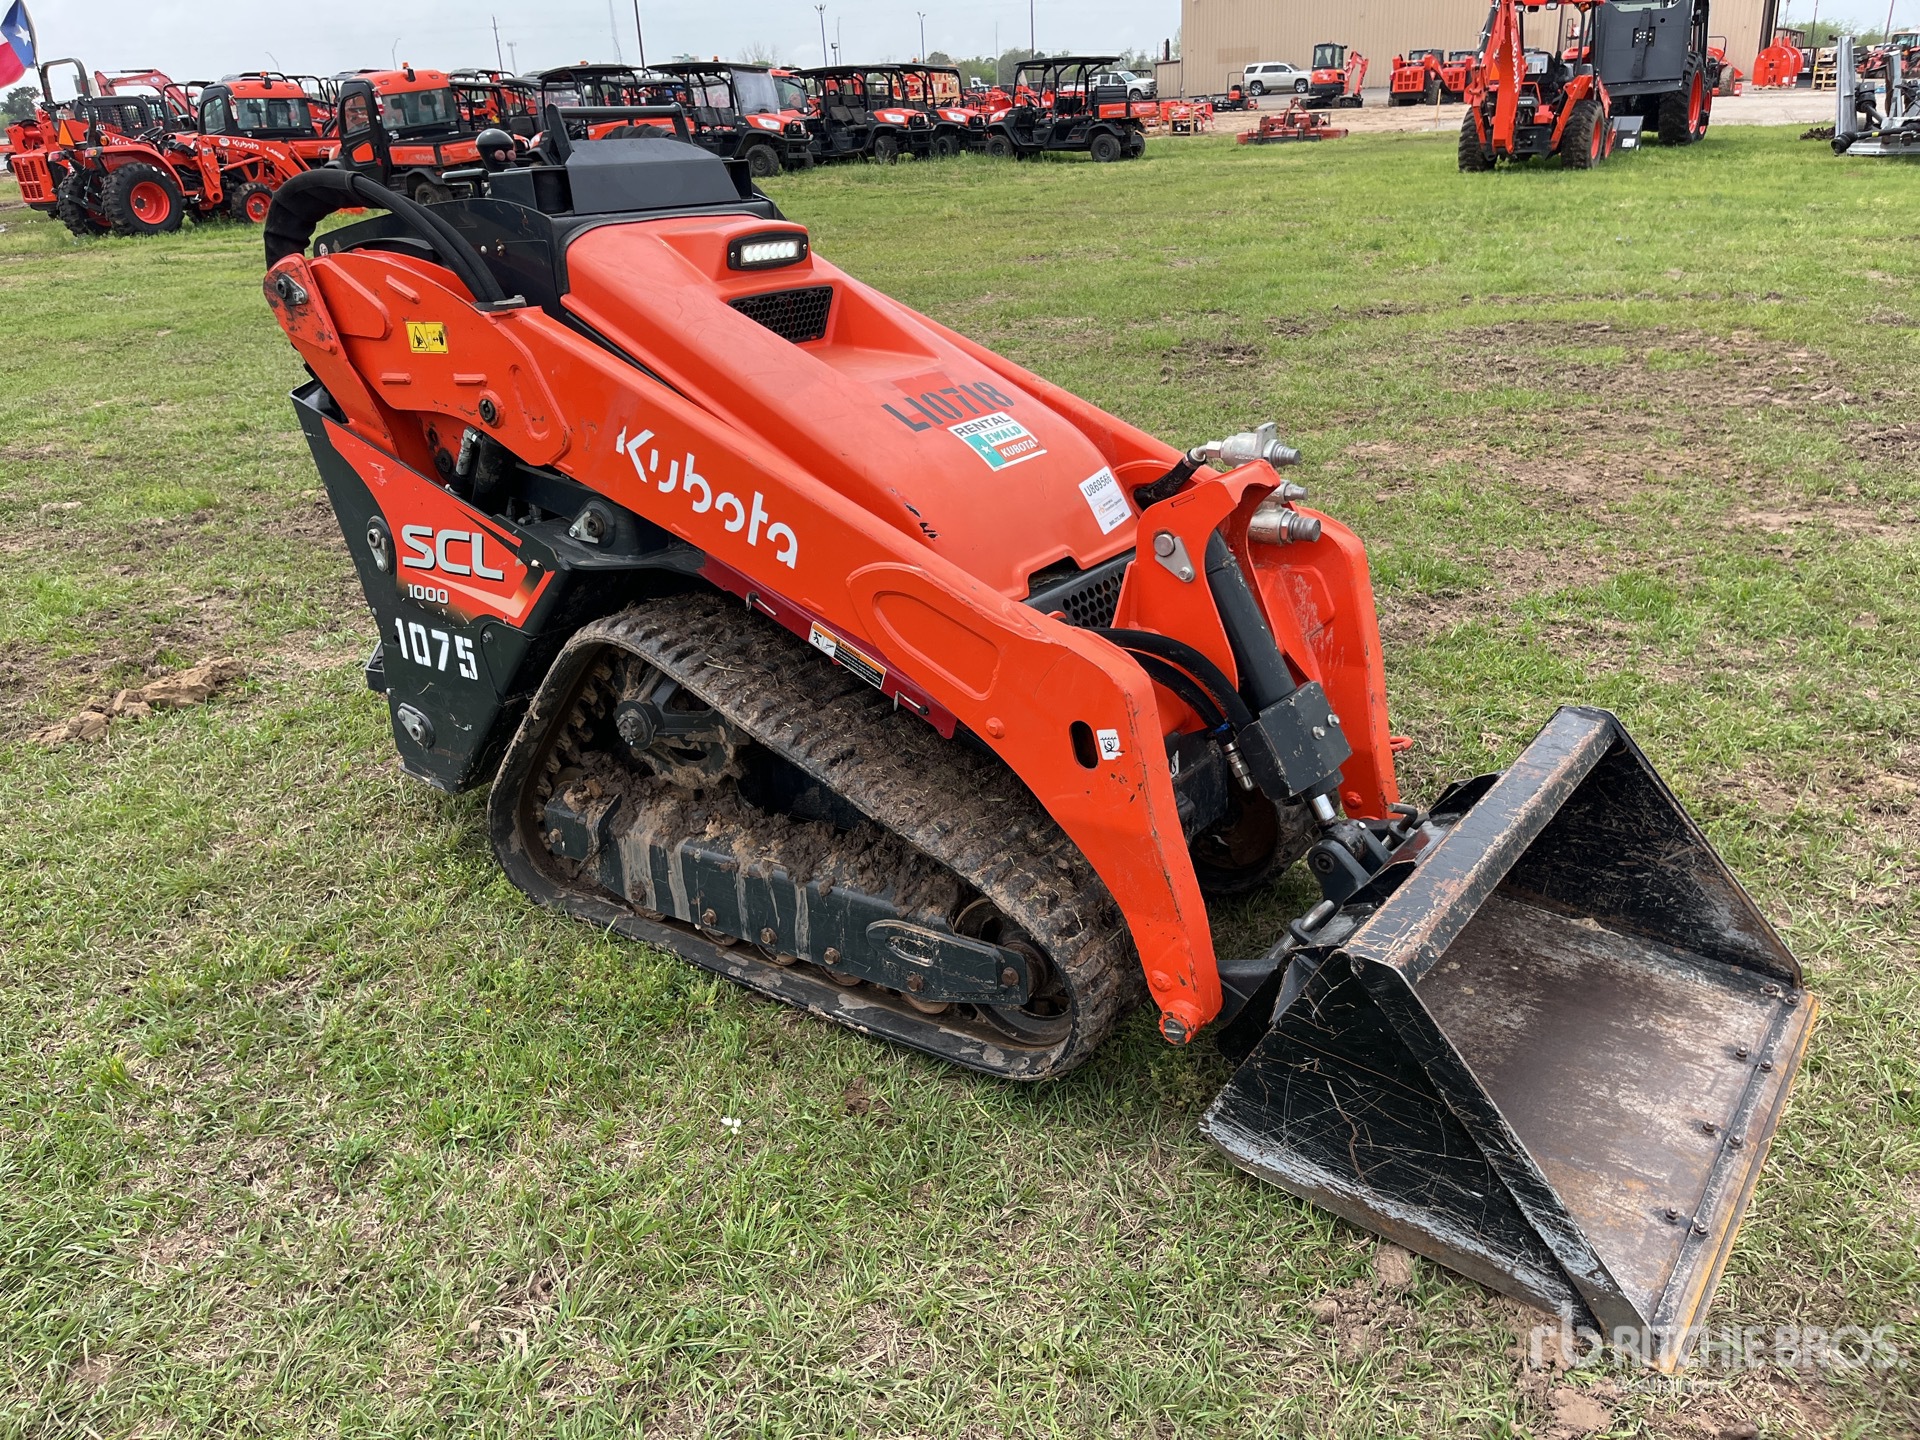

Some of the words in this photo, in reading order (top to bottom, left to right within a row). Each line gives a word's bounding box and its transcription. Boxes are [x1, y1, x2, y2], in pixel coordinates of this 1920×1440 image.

[232, 139, 259, 150] Kubota
[954, 416, 1011, 437] RENTAL
[984, 425, 1022, 443] EWALD
[1000, 439, 1036, 458] KUBOTA
[616, 425, 798, 569] Kubota
[401, 524, 504, 581] SCL
[407, 583, 449, 604] 1000
[395, 617, 479, 681] 1075
[841, 642, 861, 659] WARNING
